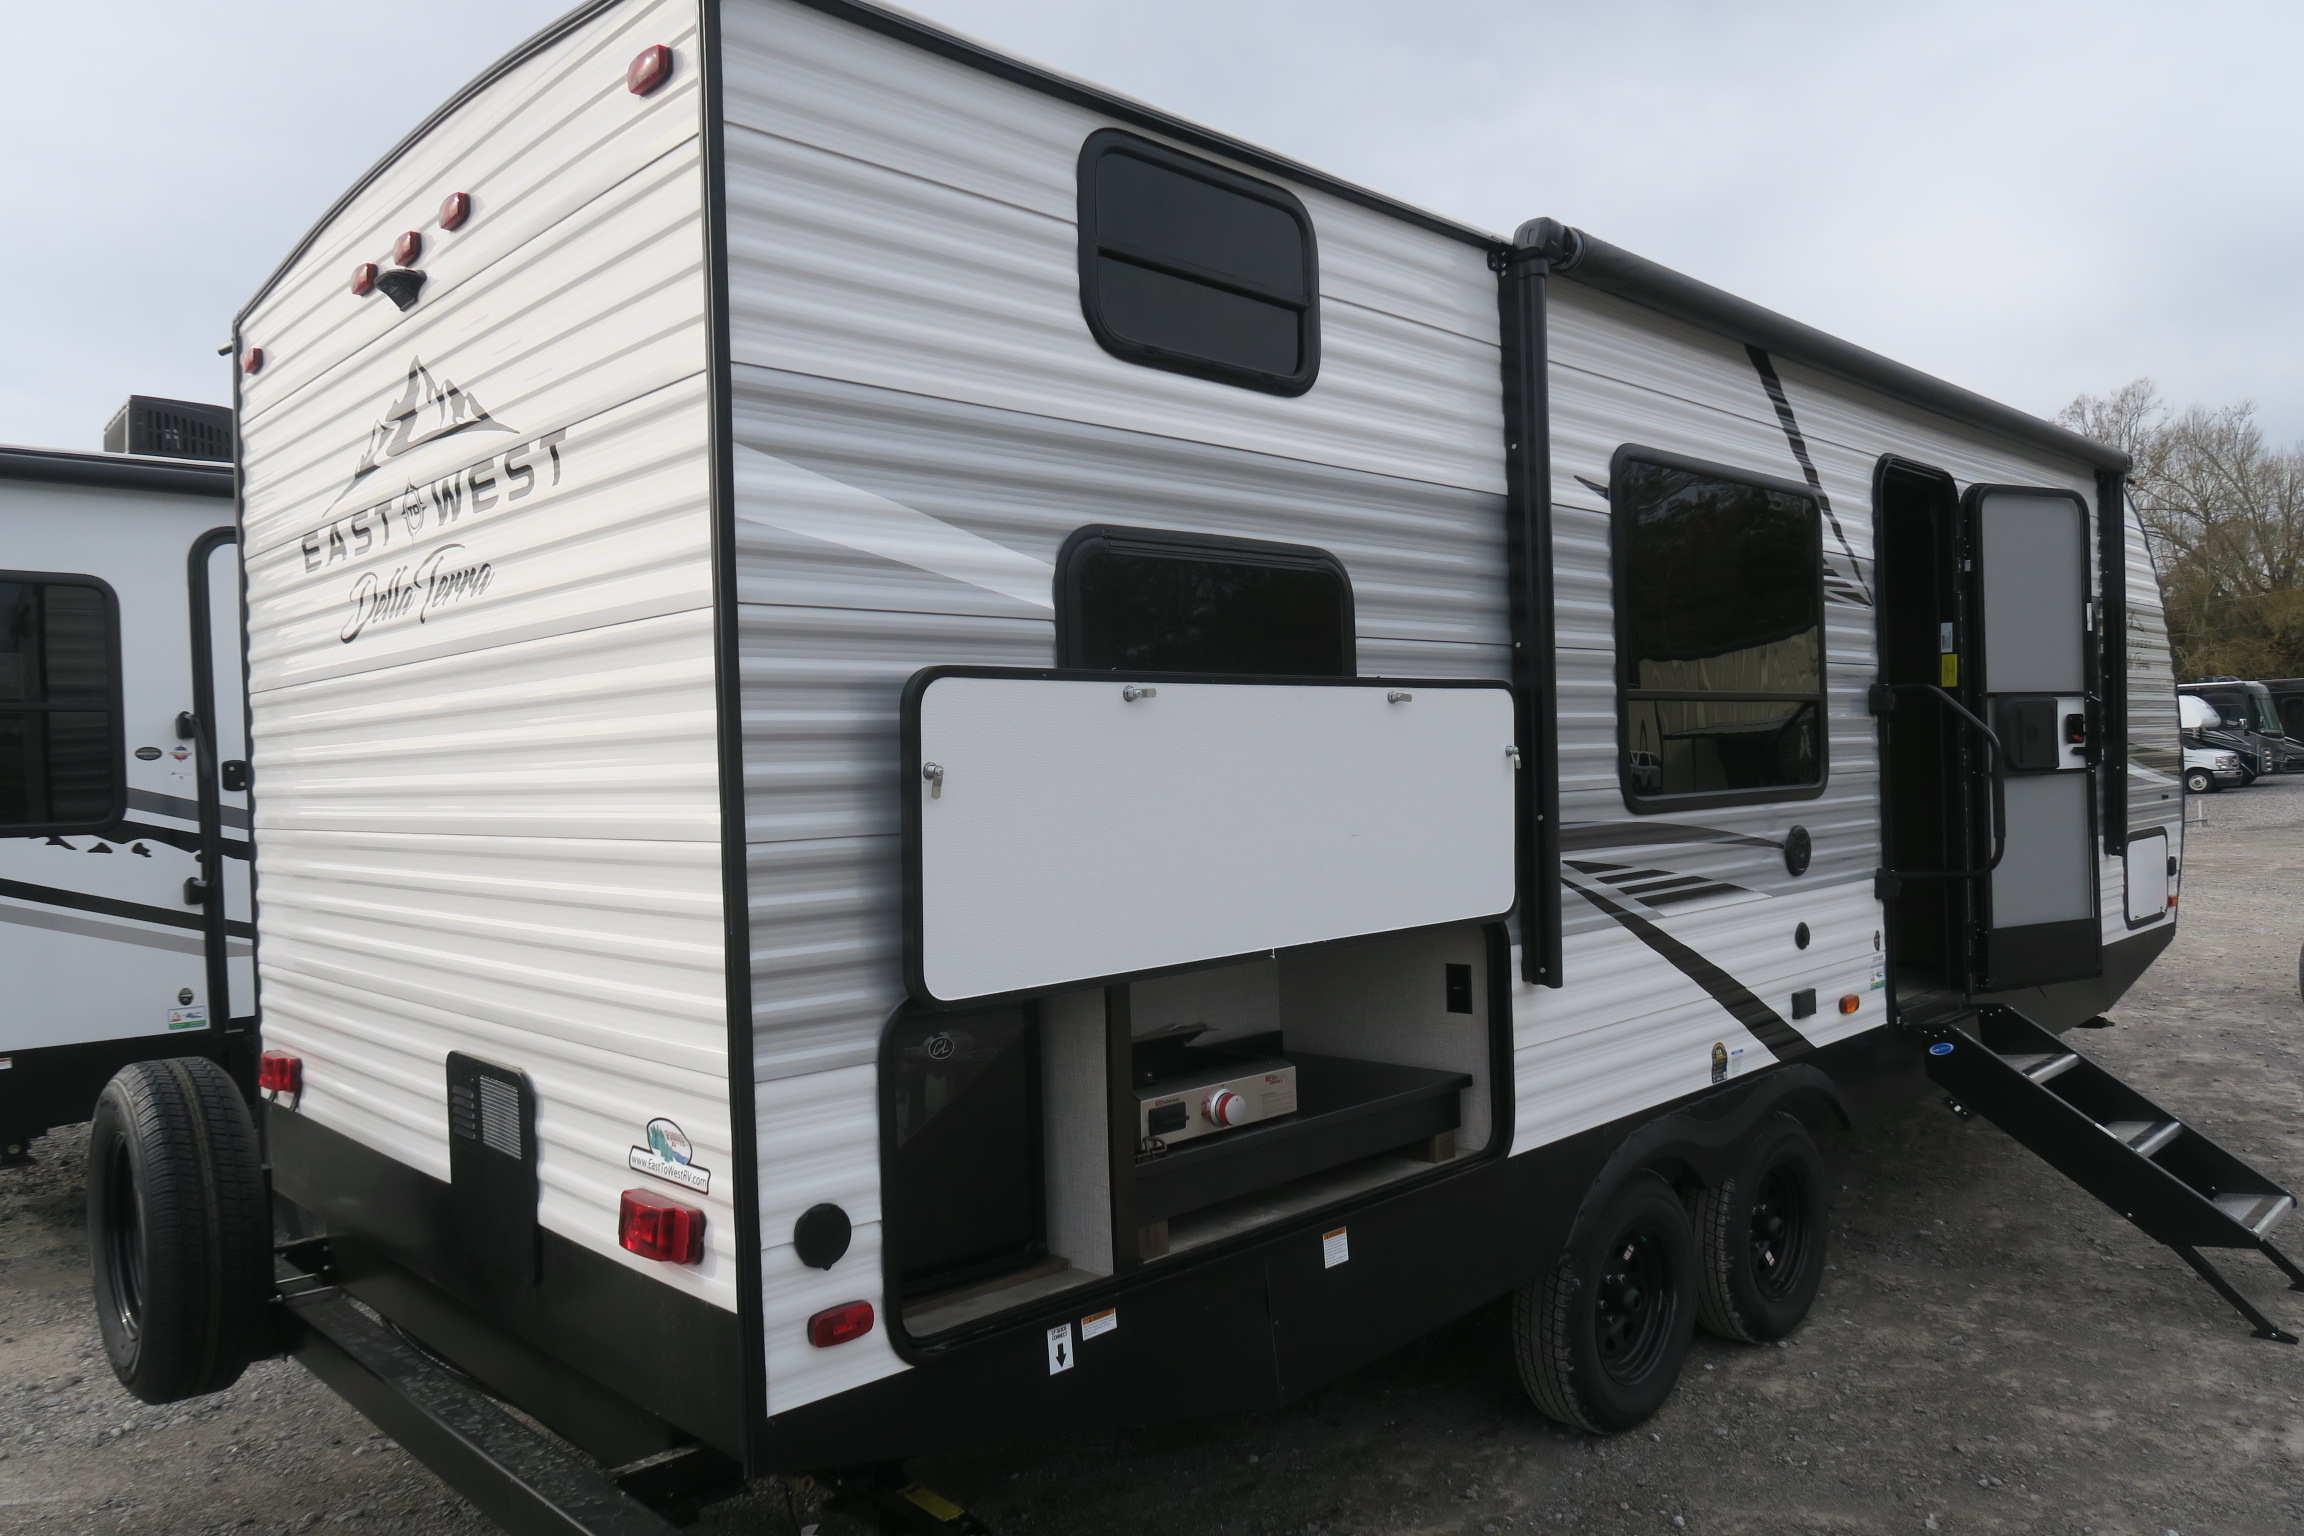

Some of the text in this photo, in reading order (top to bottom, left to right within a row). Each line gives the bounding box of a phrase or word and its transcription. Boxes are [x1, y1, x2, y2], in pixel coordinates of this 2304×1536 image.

[301, 502, 393, 574] EAST
[430, 427, 568, 527] WEST
[341, 543, 496, 644] Della Terra
[631, 1155, 707, 1188] www.EastToWestRV.com
